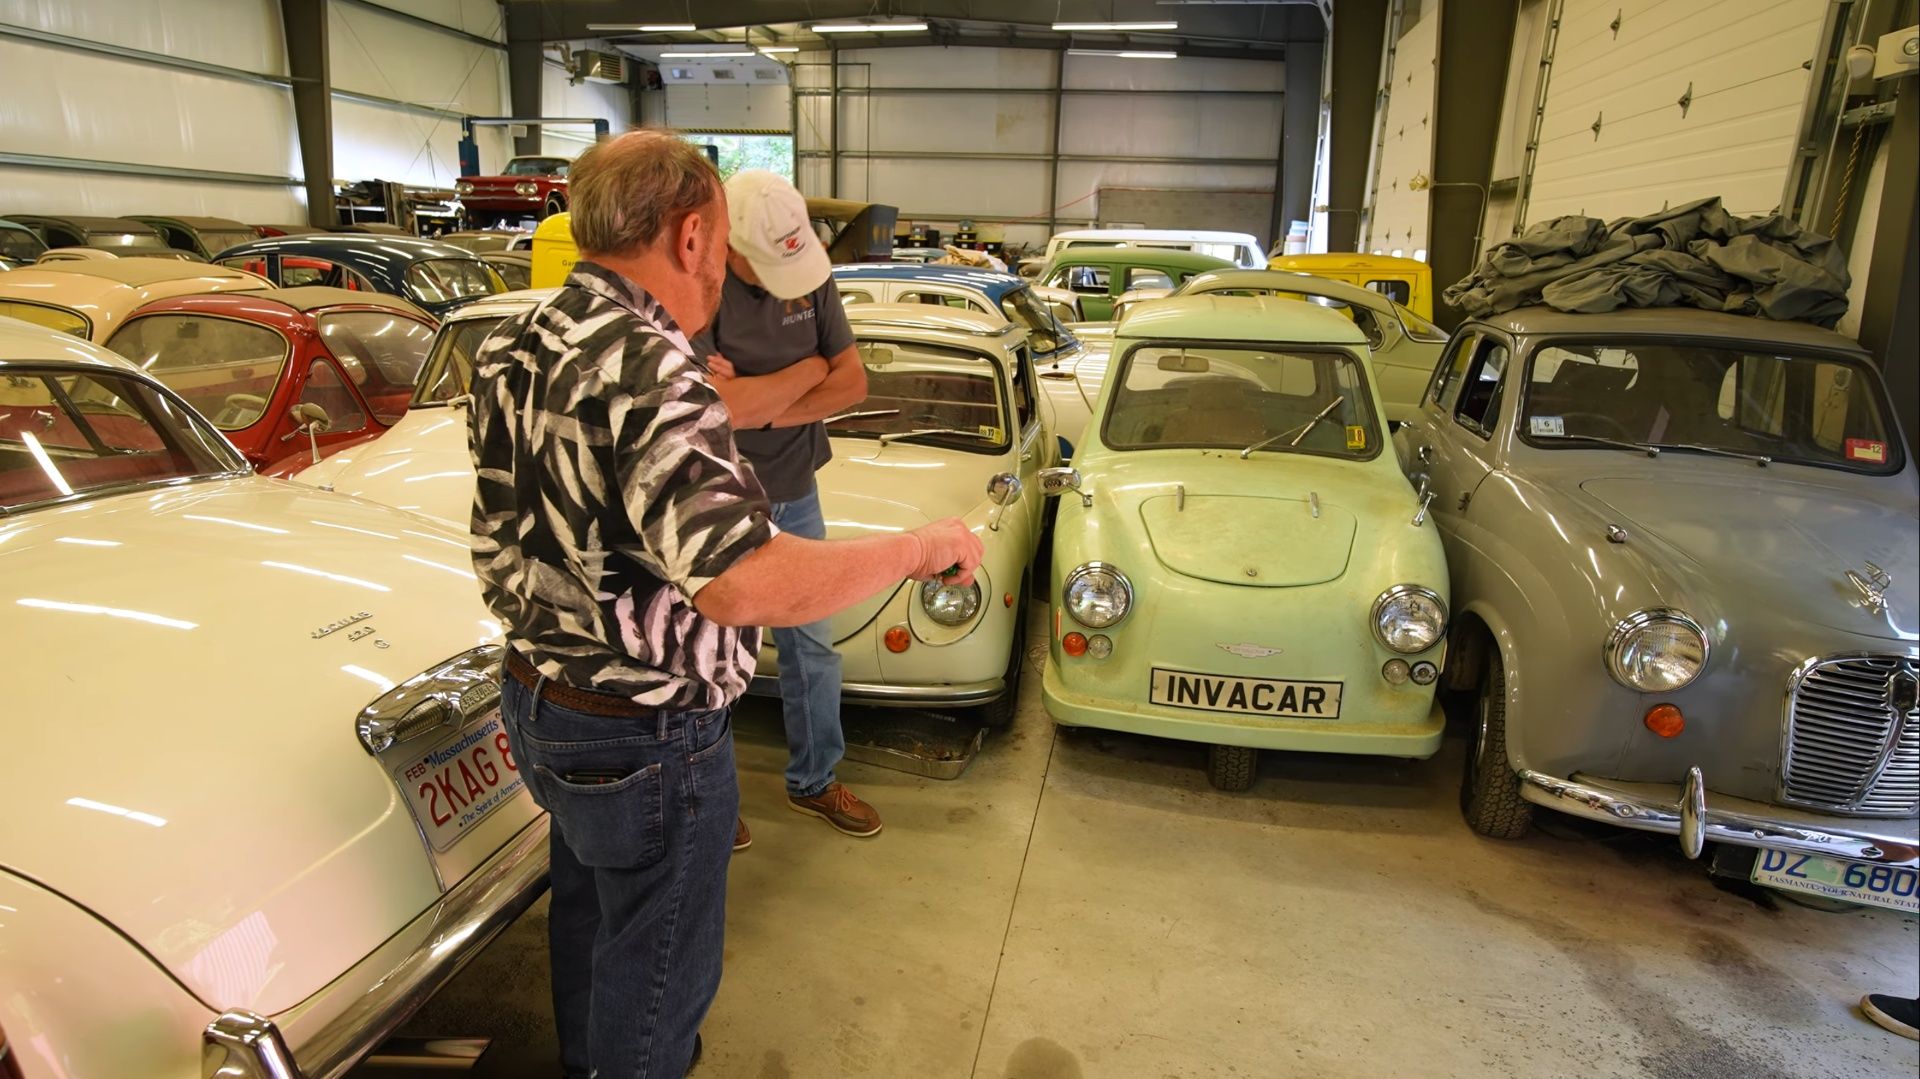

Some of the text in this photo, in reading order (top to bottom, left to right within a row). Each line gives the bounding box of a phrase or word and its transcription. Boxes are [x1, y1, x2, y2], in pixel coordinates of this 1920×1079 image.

[1871, 445, 1881, 454] 12
[1166, 675, 1327, 714] INVACAR
[427, 719, 499, 769] Massachusetts
[404, 762, 427, 783] FEB
[418, 746, 499, 828] 2KAG
[461, 812, 475, 825] The
[475, 798, 492, 815] Spirit
[493, 791, 500, 802] of
[1762, 849, 1919, 899] DZ 680
[1848, 890, 1892, 905] NATURAL
